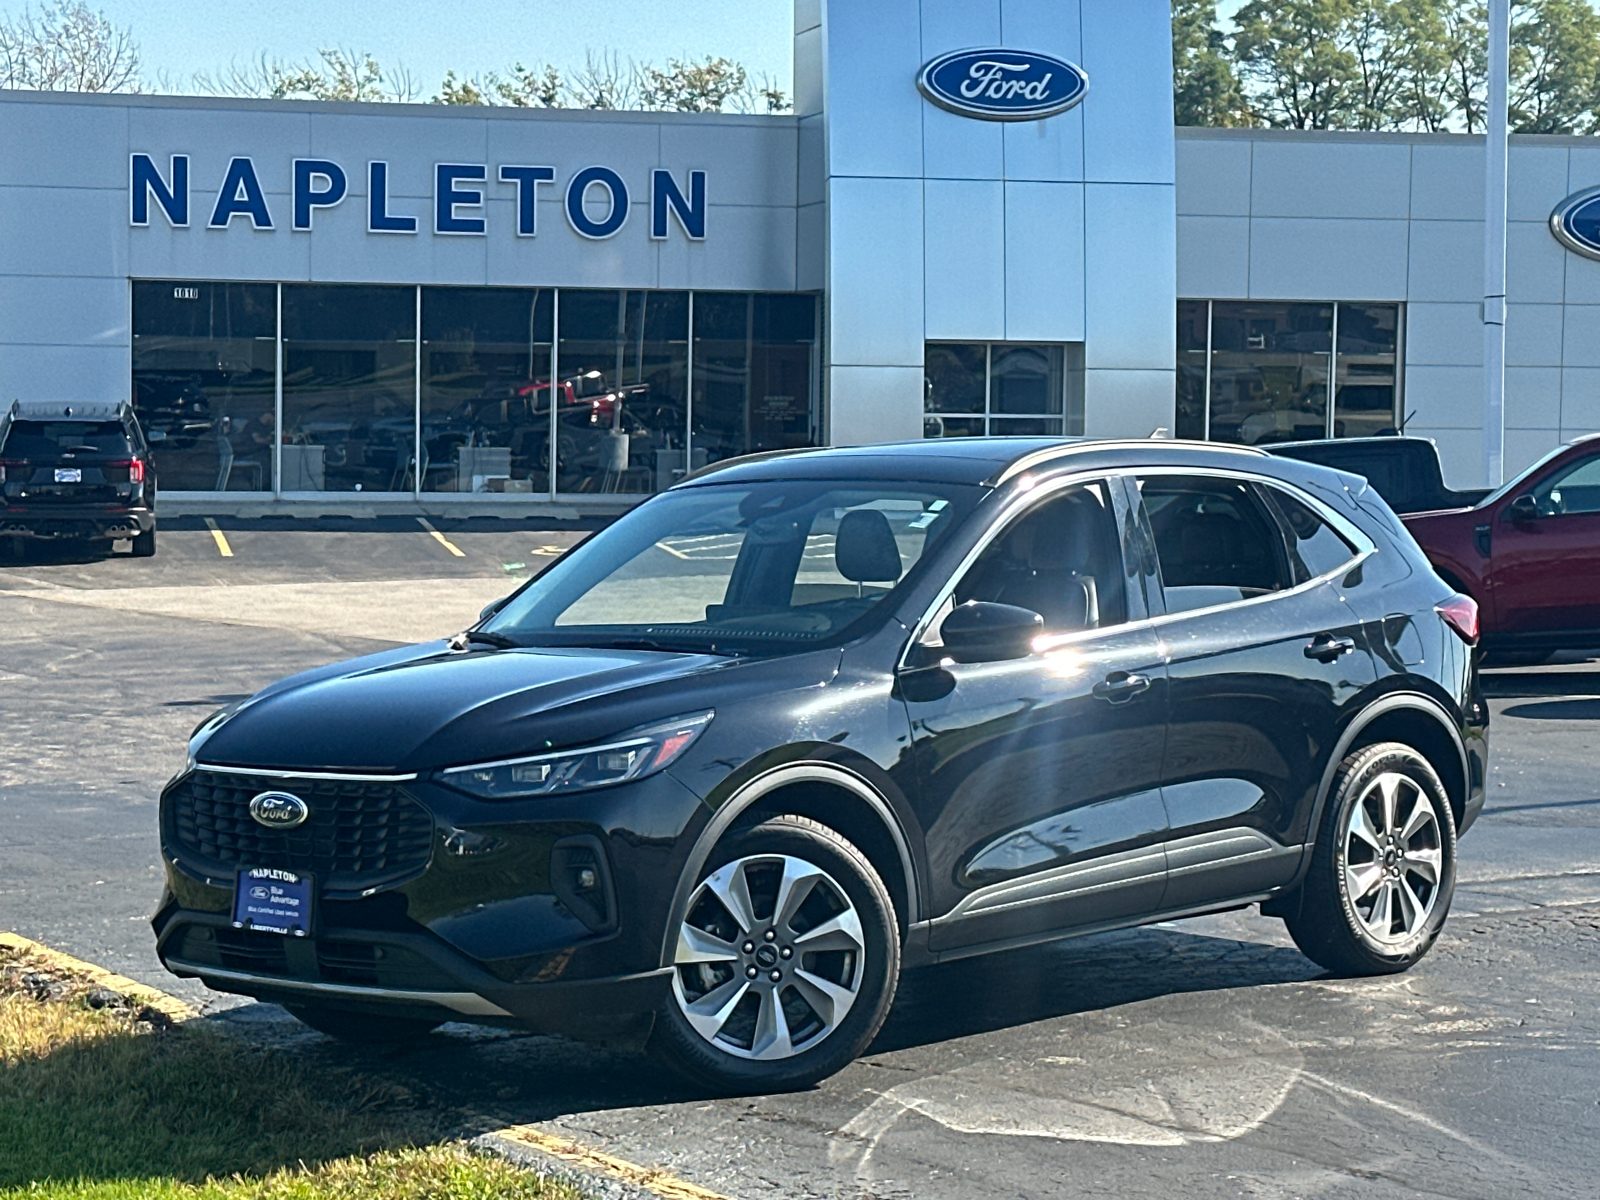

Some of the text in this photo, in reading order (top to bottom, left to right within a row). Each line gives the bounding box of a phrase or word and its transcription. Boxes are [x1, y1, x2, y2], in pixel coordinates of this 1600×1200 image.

[960, 61, 1052, 100] Ford
[129, 153, 707, 241] NAPLETON
[260, 798, 292, 820] Ford
[251, 868, 296, 883] NAPLETON
[270, 886, 283, 895] Blue
[270, 895, 300, 907] Advantage
